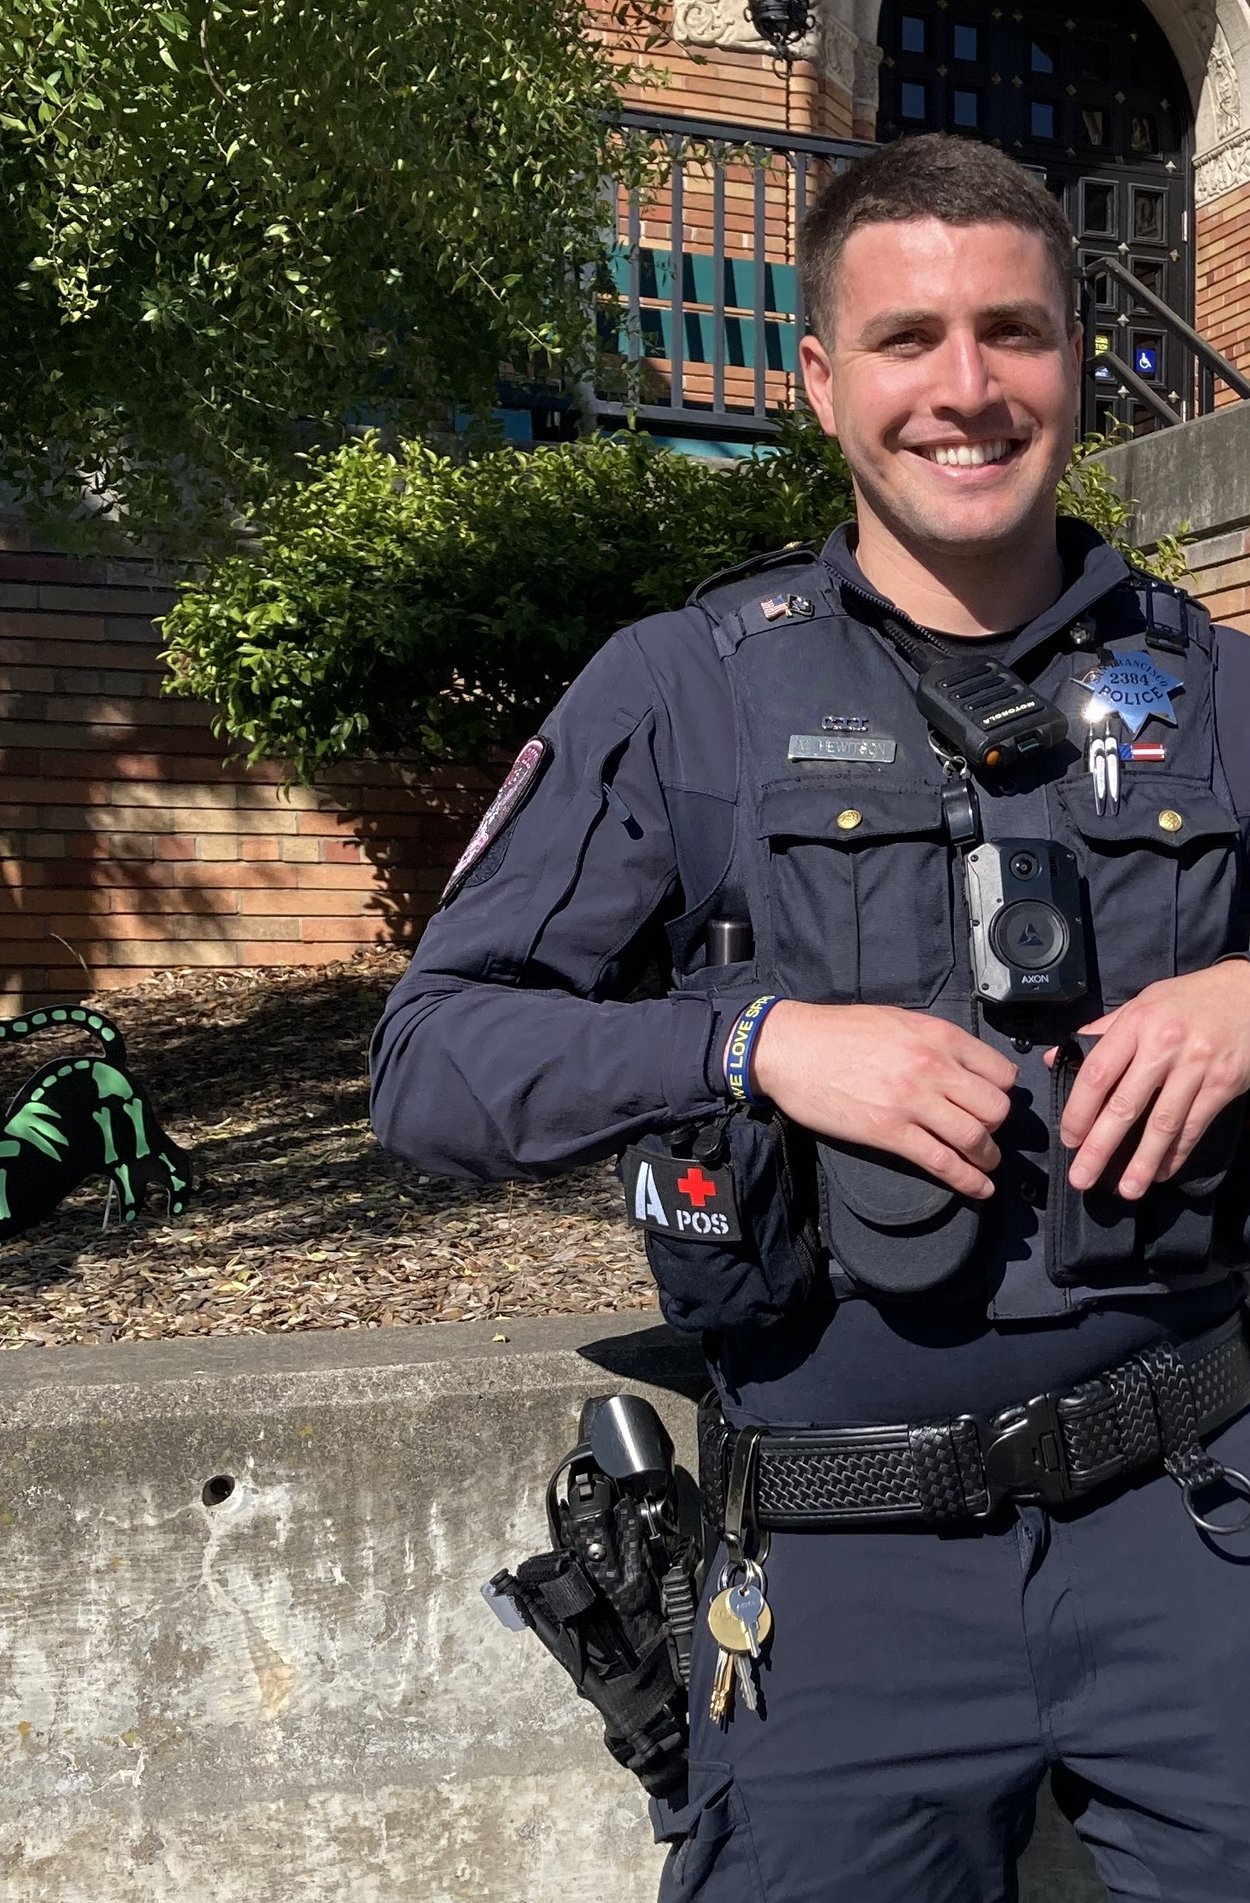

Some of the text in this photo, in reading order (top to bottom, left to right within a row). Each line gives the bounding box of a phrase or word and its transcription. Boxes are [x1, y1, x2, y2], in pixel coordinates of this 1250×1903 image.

[1110, 672, 1150, 686] 2384
[1099, 685, 1163, 705] POLICE
[983, 701, 1036, 724] MOTOROLA
[1021, 974, 1050, 984] AXON
[730, 1020, 754, 1068] LOVE
[730, 1074, 746, 1100] WE
[635, 1161, 729, 1234] A POS
